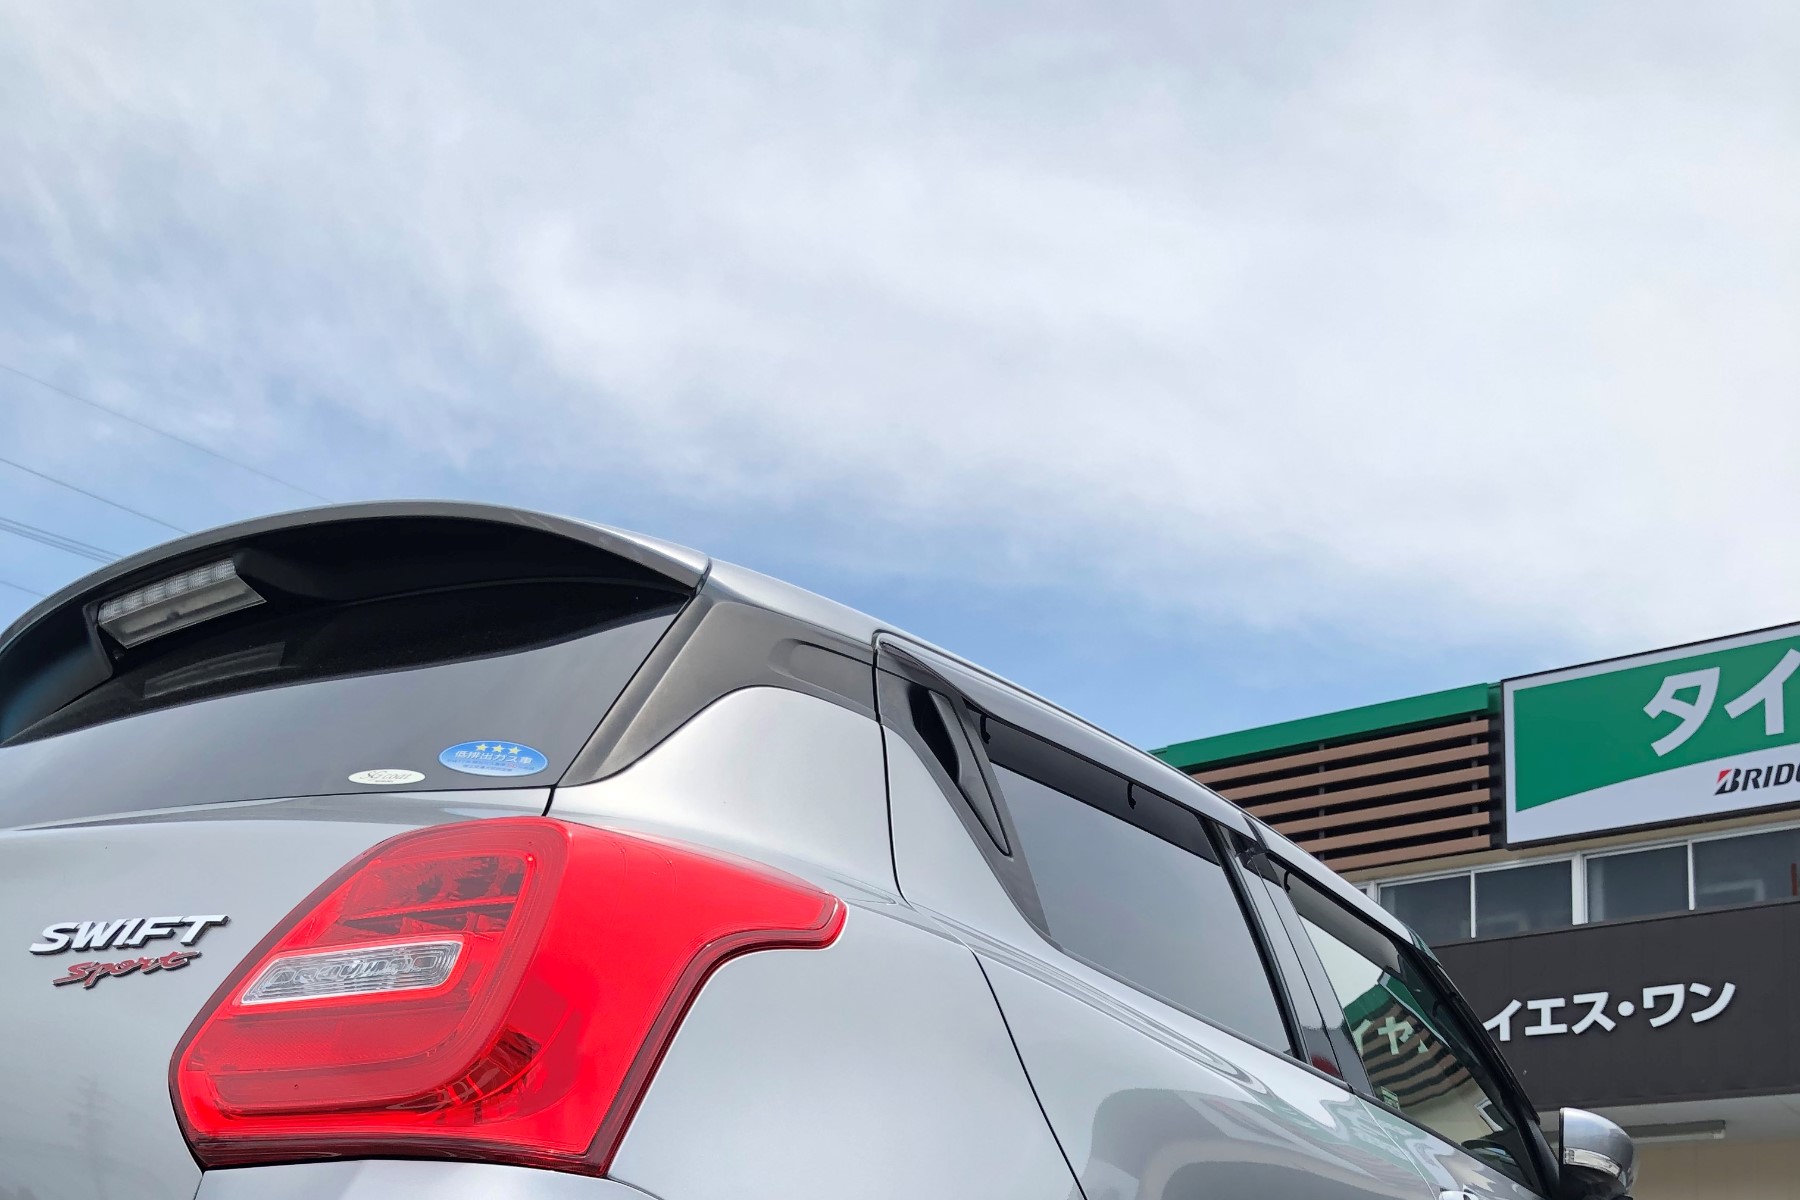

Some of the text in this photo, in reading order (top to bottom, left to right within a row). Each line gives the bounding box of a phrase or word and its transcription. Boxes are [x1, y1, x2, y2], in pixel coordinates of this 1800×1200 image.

[1643, 648, 1800, 757] タイ
[455, 750, 534, 765] 低排出ガス車
[28, 914, 231, 955] SWIFT
[52, 950, 203, 989] Sport
